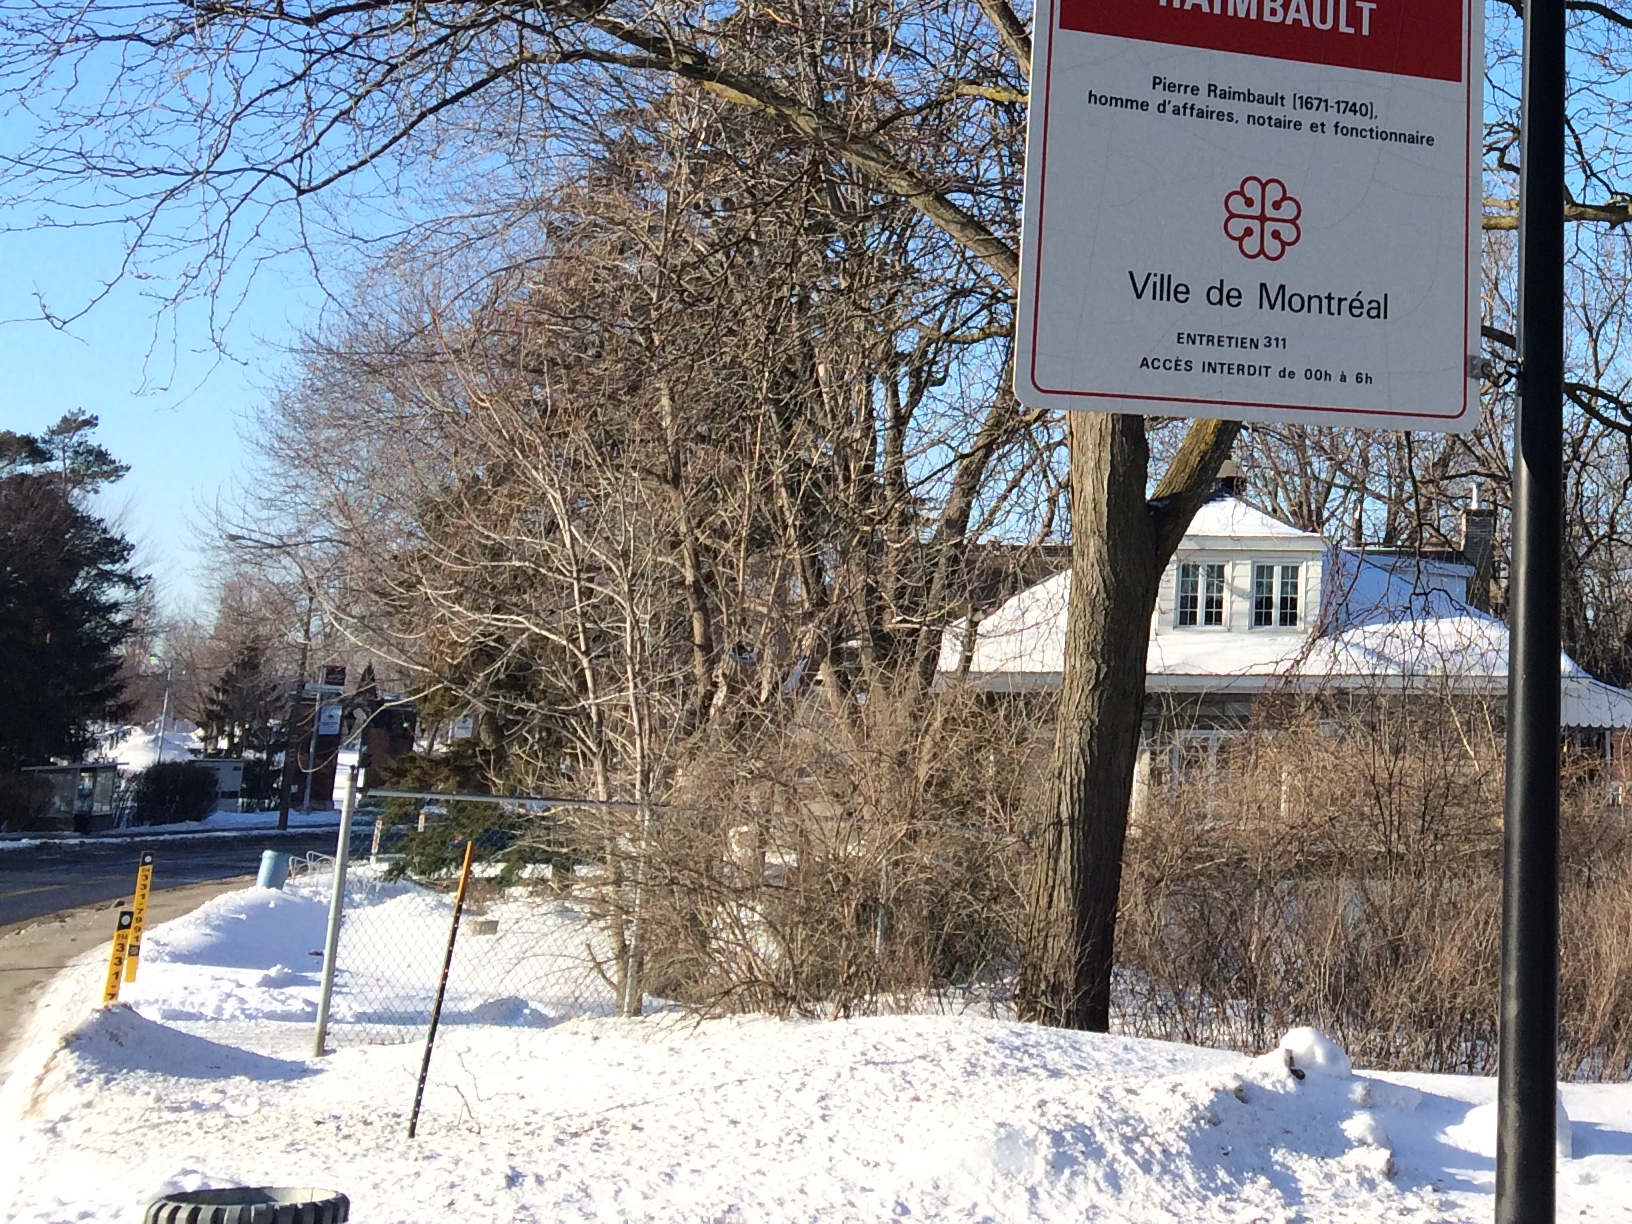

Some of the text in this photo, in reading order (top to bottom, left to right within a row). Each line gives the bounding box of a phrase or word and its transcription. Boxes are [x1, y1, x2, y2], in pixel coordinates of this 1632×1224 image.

[1152, 75, 1200, 96] Pierre
[1207, 82, 1286, 108] Raimbault
[1087, 89, 1435, 146] homme d'affaires, notaire et fonctionnaire
[1128, 270, 1389, 320] Ville de Montréal
[1176, 332, 1287, 350] ENTRETIEN 311
[1139, 355, 1373, 385] ACCÈS INTERDIT de 00h à 6h
